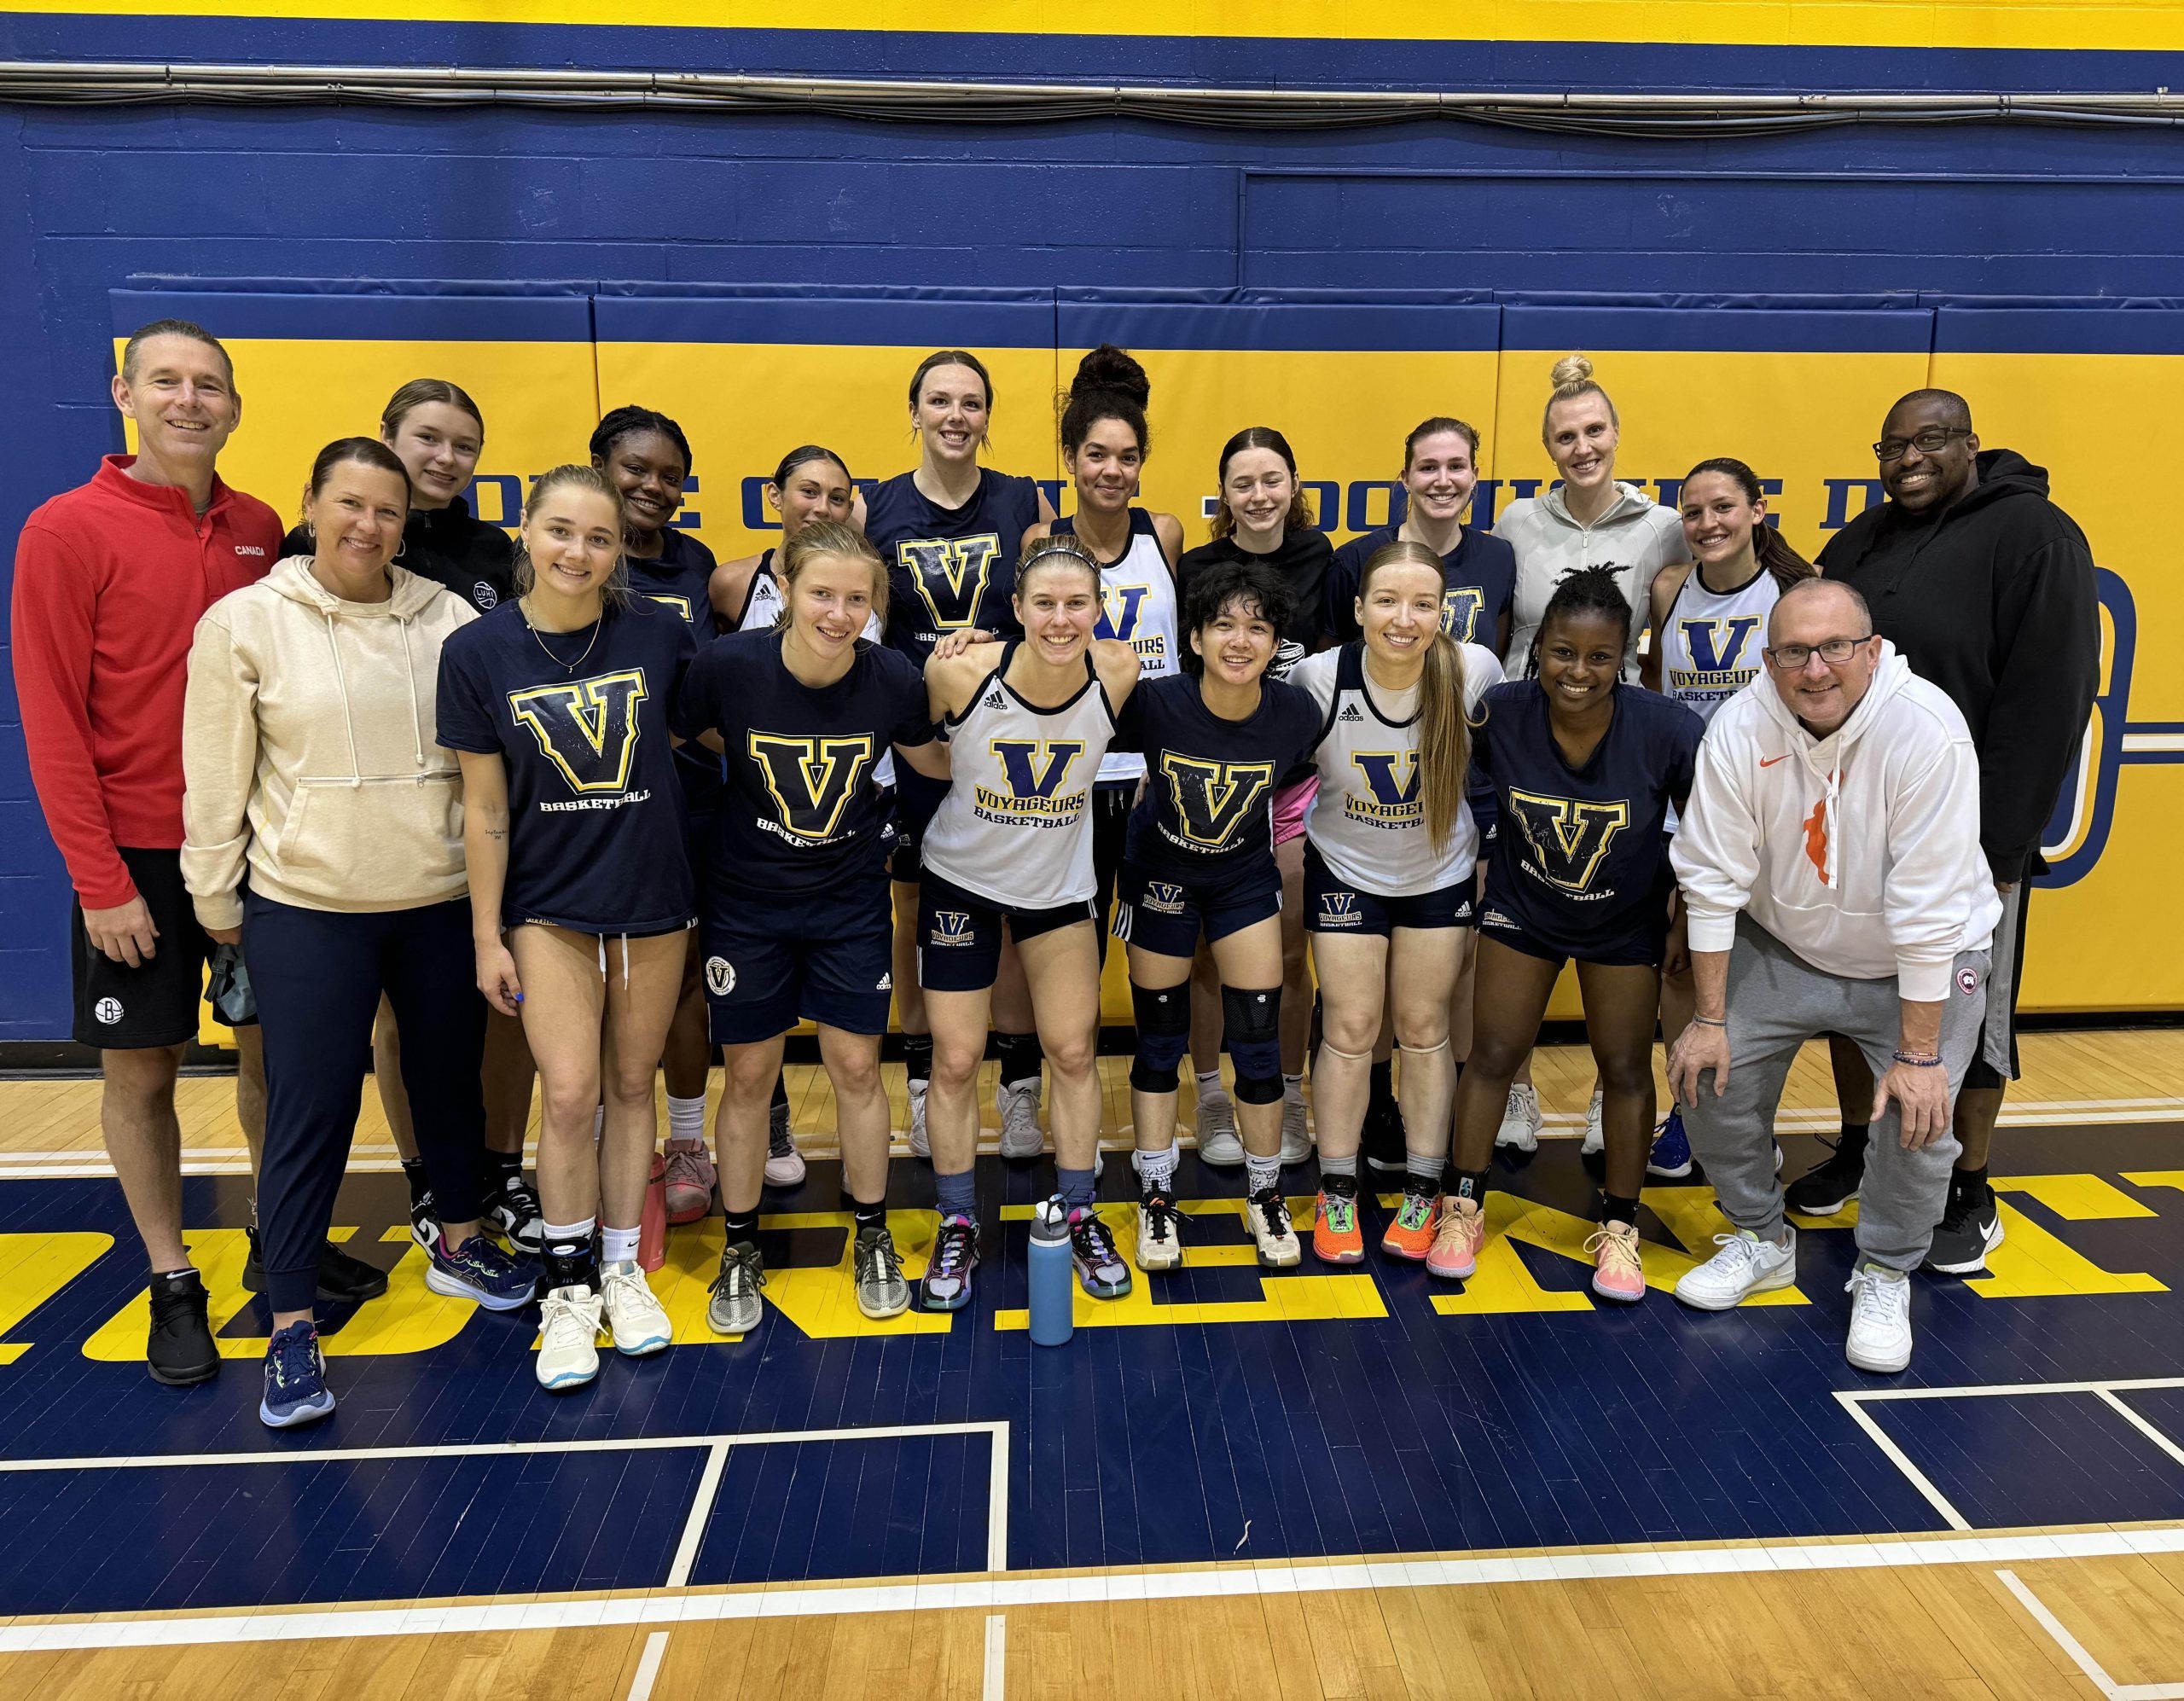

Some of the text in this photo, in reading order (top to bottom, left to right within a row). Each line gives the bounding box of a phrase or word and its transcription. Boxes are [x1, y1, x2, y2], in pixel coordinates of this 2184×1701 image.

[235, 545, 265, 556] CANADA
[476, 589, 494, 598] LUHI
[896, 532, 1002, 630] V
[1678, 613, 1763, 672] V
[1669, 669, 1761, 688] VOYAGEUR
[984, 700, 1008, 711] adidas
[506, 667, 650, 795] V
[990, 738, 1086, 798] V
[1351, 751, 1426, 805] V
[747, 728, 874, 841] V
[539, 789, 652, 812] BASKETBALL
[974, 785, 1087, 815] VOYAGEURS
[1159, 748, 1275, 849] V
[973, 805, 1080, 828] BASKETBALL
[1509, 785, 1630, 893] V
[1148, 881, 1182, 904] V
[1321, 892, 1356, 916] V
[936, 910, 970, 937] V
[1318, 911, 1362, 922] VOYAGEURS
[709, 965, 730, 990] V
